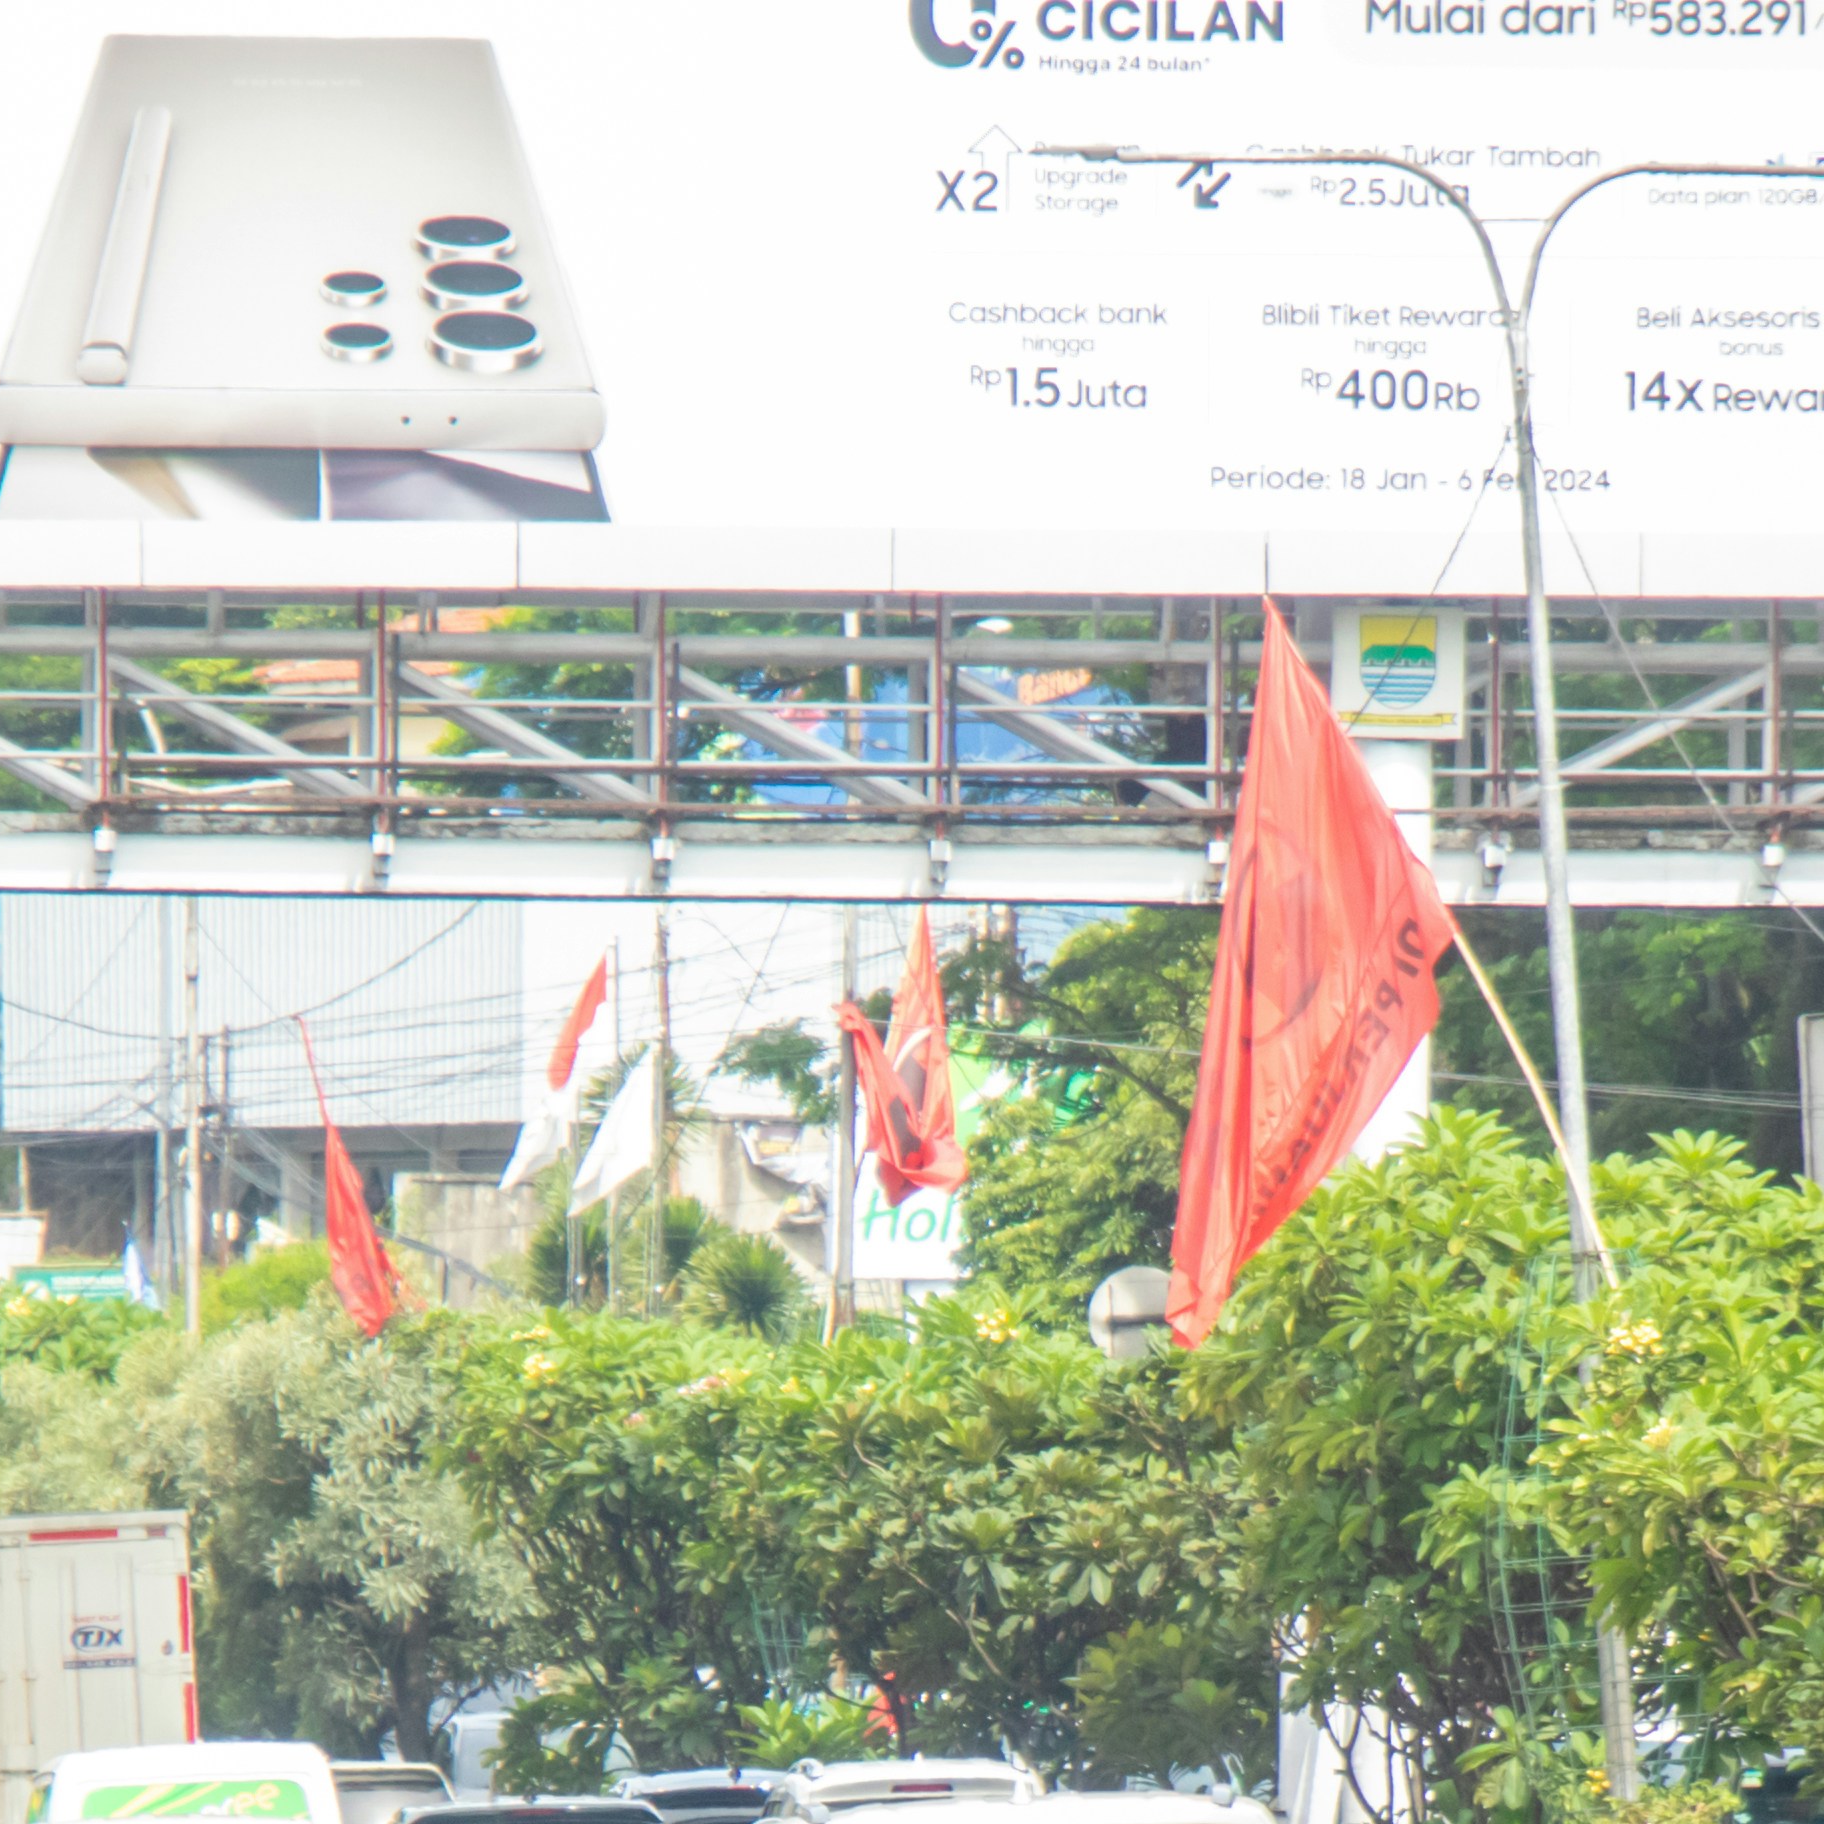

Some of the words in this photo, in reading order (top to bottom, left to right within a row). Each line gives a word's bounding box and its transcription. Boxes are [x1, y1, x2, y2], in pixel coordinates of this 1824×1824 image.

[1035, 0, 1284, 43] CICILAN
[1364, 0, 1484, 36] Mulai
[1500, 0, 1597, 36] dari
[1039, 56, 1111, 75] Hingga
[1118, 56, 1141, 71] 24
[1401, 144, 1475, 168] Tukar
[1488, 145, 1600, 168] Tambah
[1034, 168, 1129, 191] Upgrade
[935, 170, 1000, 213] X2
[1649, 189, 1698, 204] Data
[1705, 187, 1750, 210] plan
[1034, 193, 1119, 217] Storage
[949, 302, 1087, 324] Cashback
[1099, 304, 1167, 325] bank
[1262, 303, 1319, 326] Blibli
[1329, 304, 1390, 327] Tiket
[1637, 306, 1681, 329] Beli
[1690, 307, 1820, 329] Aksesoris
[1021, 335, 1095, 358] hingga
[1354, 337, 1427, 360] hingga
[1718, 340, 1783, 357] bonus
[1211, 465, 1330, 490] Periode:
[1341, 468, 1365, 490] 18
[1377, 469, 1427, 491] Jan
[1458, 469, 1472, 491] 6
[1543, 468, 1611, 490] 2024
